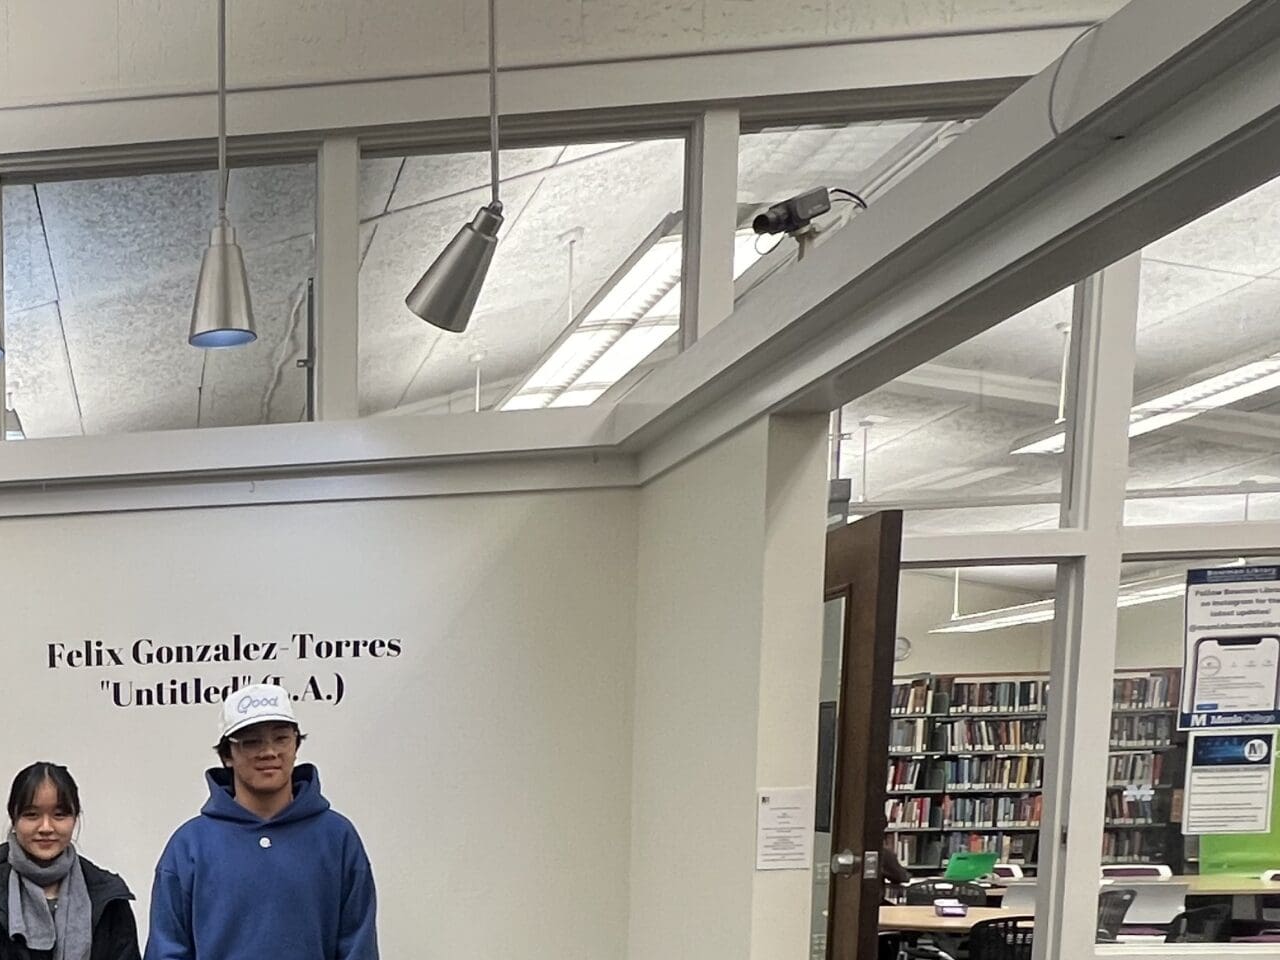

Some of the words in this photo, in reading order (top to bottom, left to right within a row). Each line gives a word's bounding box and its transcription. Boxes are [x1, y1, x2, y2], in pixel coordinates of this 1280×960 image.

[48, 640, 124, 668] Felix
[132, 633, 402, 665] Gonzalez-Torres
[100, 675, 251, 707] "Untitled"
[261, 672, 345, 706] .A.)
[1191, 713, 1208, 727] M
